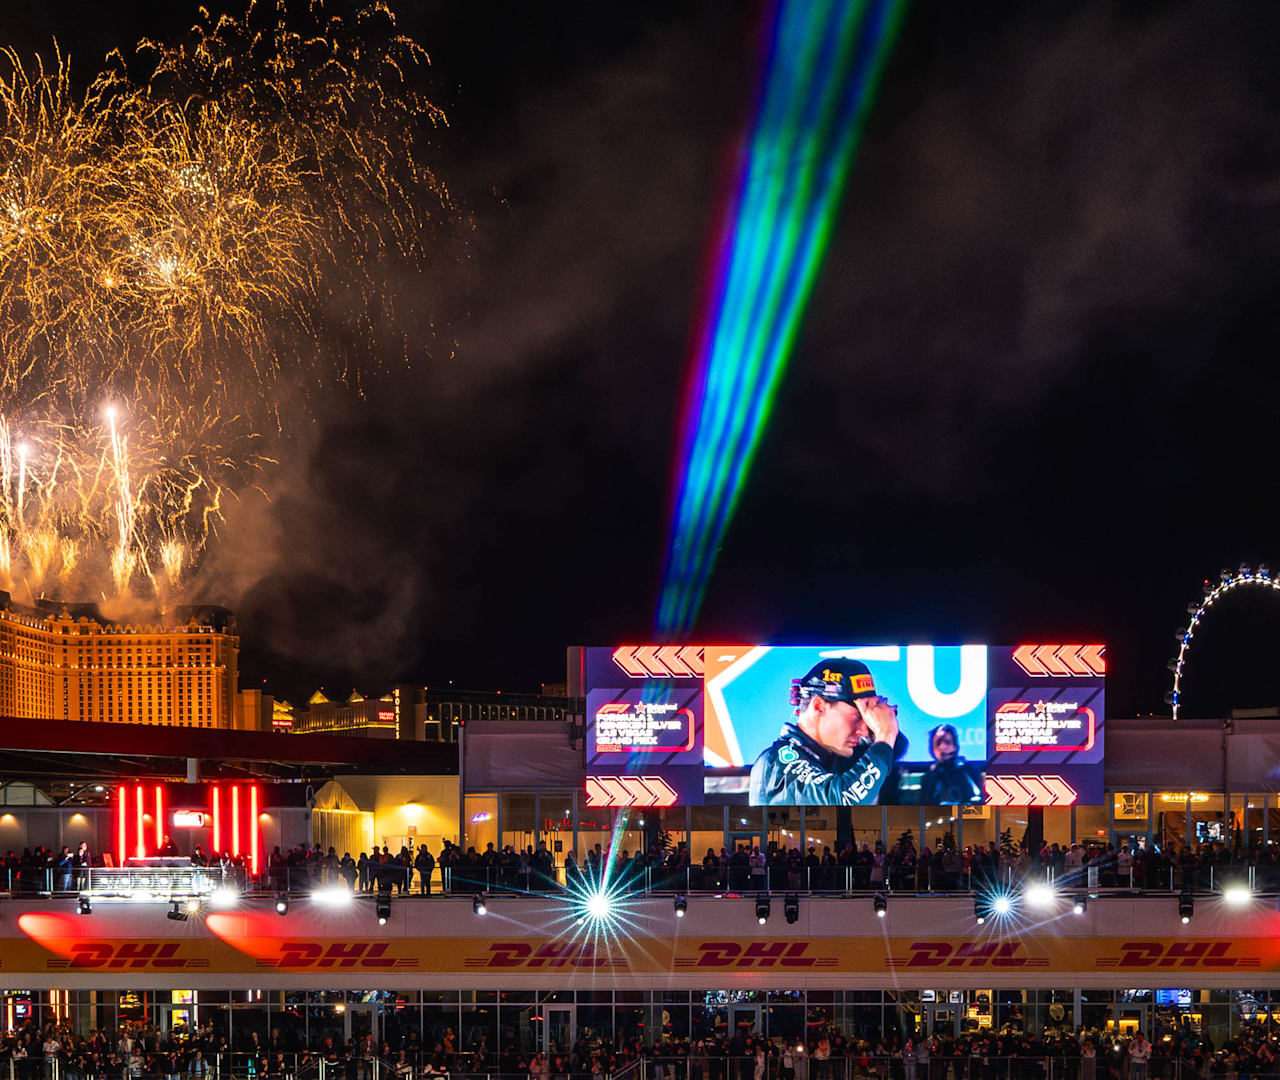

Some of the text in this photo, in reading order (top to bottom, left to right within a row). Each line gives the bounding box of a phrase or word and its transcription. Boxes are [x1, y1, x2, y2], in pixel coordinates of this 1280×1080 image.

[823, 669, 843, 682] 1ST
[596, 729, 653, 737] LAS VEGAS
[996, 728, 1053, 736] LAS VEGAS
[70, 943, 187, 967] DHL
[279, 943, 396, 967] DHL
[488, 943, 608, 967] DHL
[698, 943, 816, 967] DHL
[908, 943, 1027, 967] DHL
[1121, 943, 1239, 967] DHL
